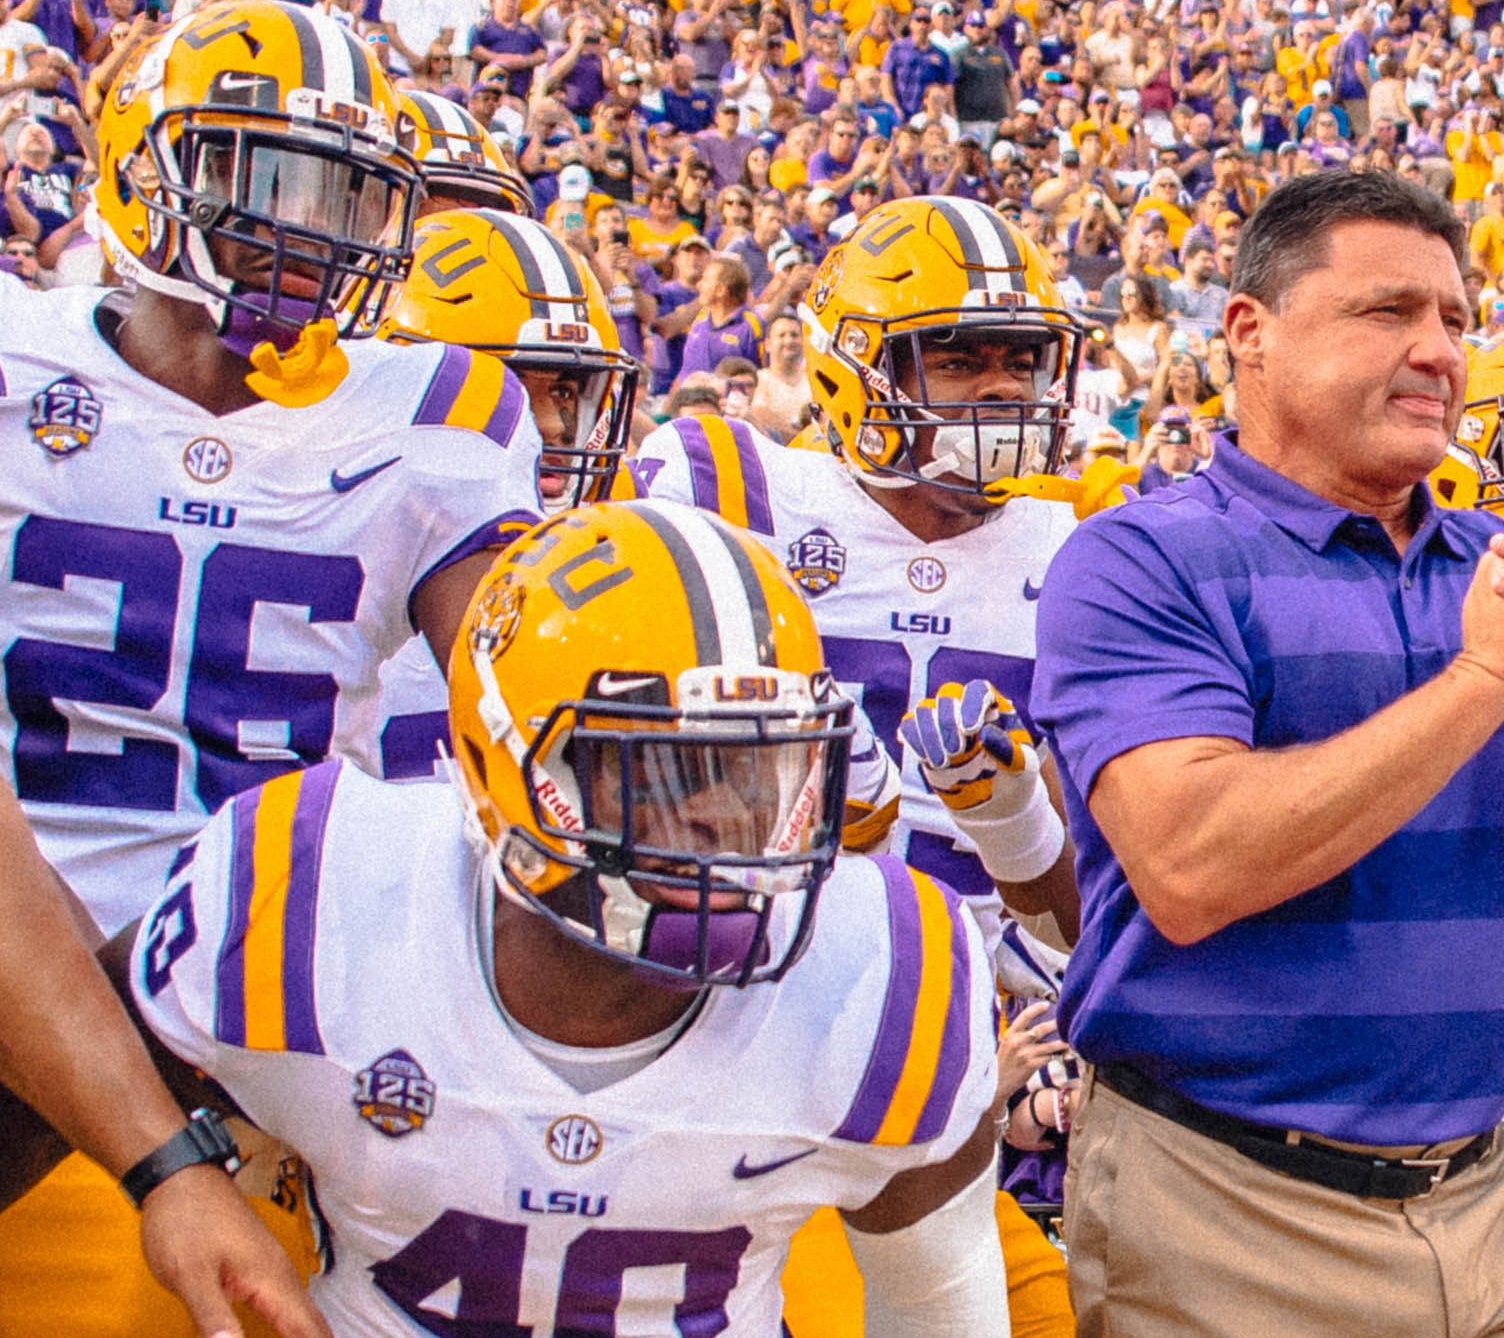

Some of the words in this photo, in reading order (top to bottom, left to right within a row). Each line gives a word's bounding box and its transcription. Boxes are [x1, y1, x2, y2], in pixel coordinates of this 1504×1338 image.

[315, 97, 368, 129] LSU
[545, 322, 589, 343] LSU
[29, 394, 102, 433] 125
[184, 438, 229, 481] SEC
[158, 496, 237, 528] LSU
[787, 542, 846, 575] 125
[908, 557, 946, 591] SEC
[891, 612, 951, 635] LSU
[4, 513, 366, 816] 26
[713, 675, 779, 703] LSU
[535, 779, 588, 845] Ridd
[777, 785, 815, 853] Riddell
[353, 1068, 436, 1118] 125
[549, 1115, 601, 1162] SEC
[520, 1189, 607, 1217] LSU
